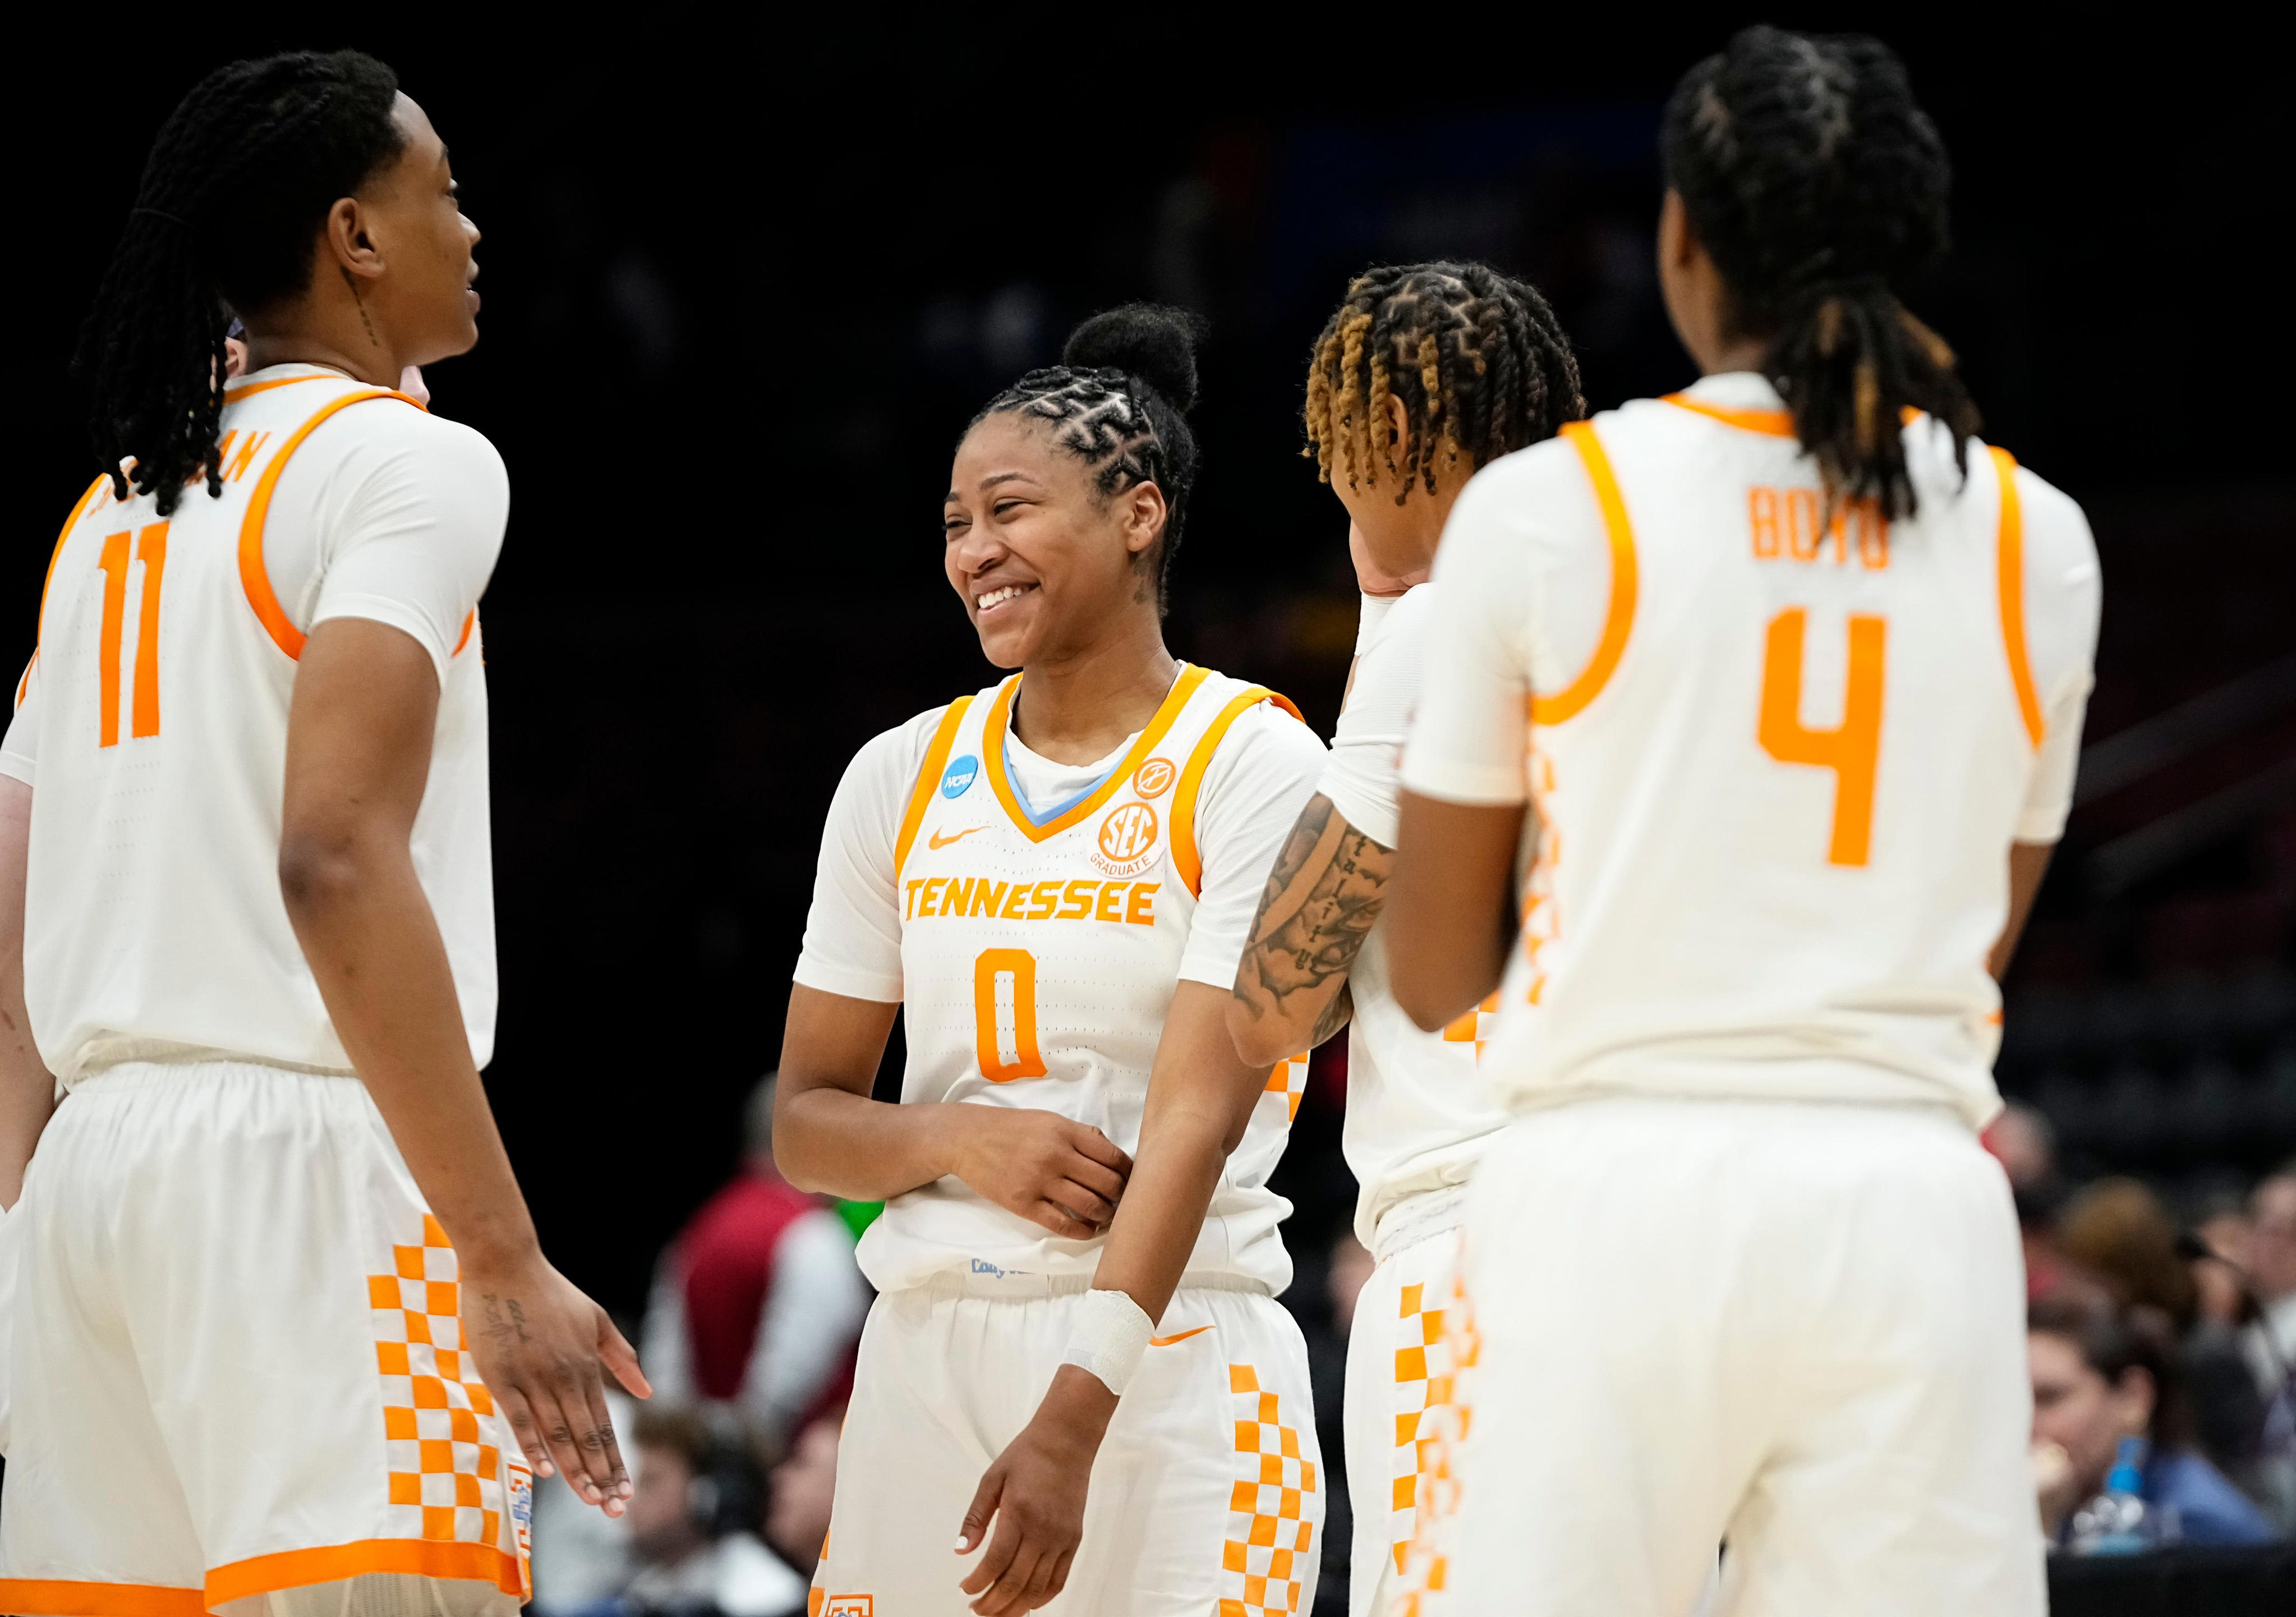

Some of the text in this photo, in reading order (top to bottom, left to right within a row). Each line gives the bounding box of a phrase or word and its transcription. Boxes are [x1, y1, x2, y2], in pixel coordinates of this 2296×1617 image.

[97, 520, 171, 748] 11
[1755, 605, 1888, 870] 4
[944, 772, 974, 790] NCAA
[1103, 806, 1153, 857] SEC
[1090, 852, 1151, 875] GRADUATE
[905, 877, 1162, 926] TENNESSEE
[974, 948, 1048, 1083] 0
